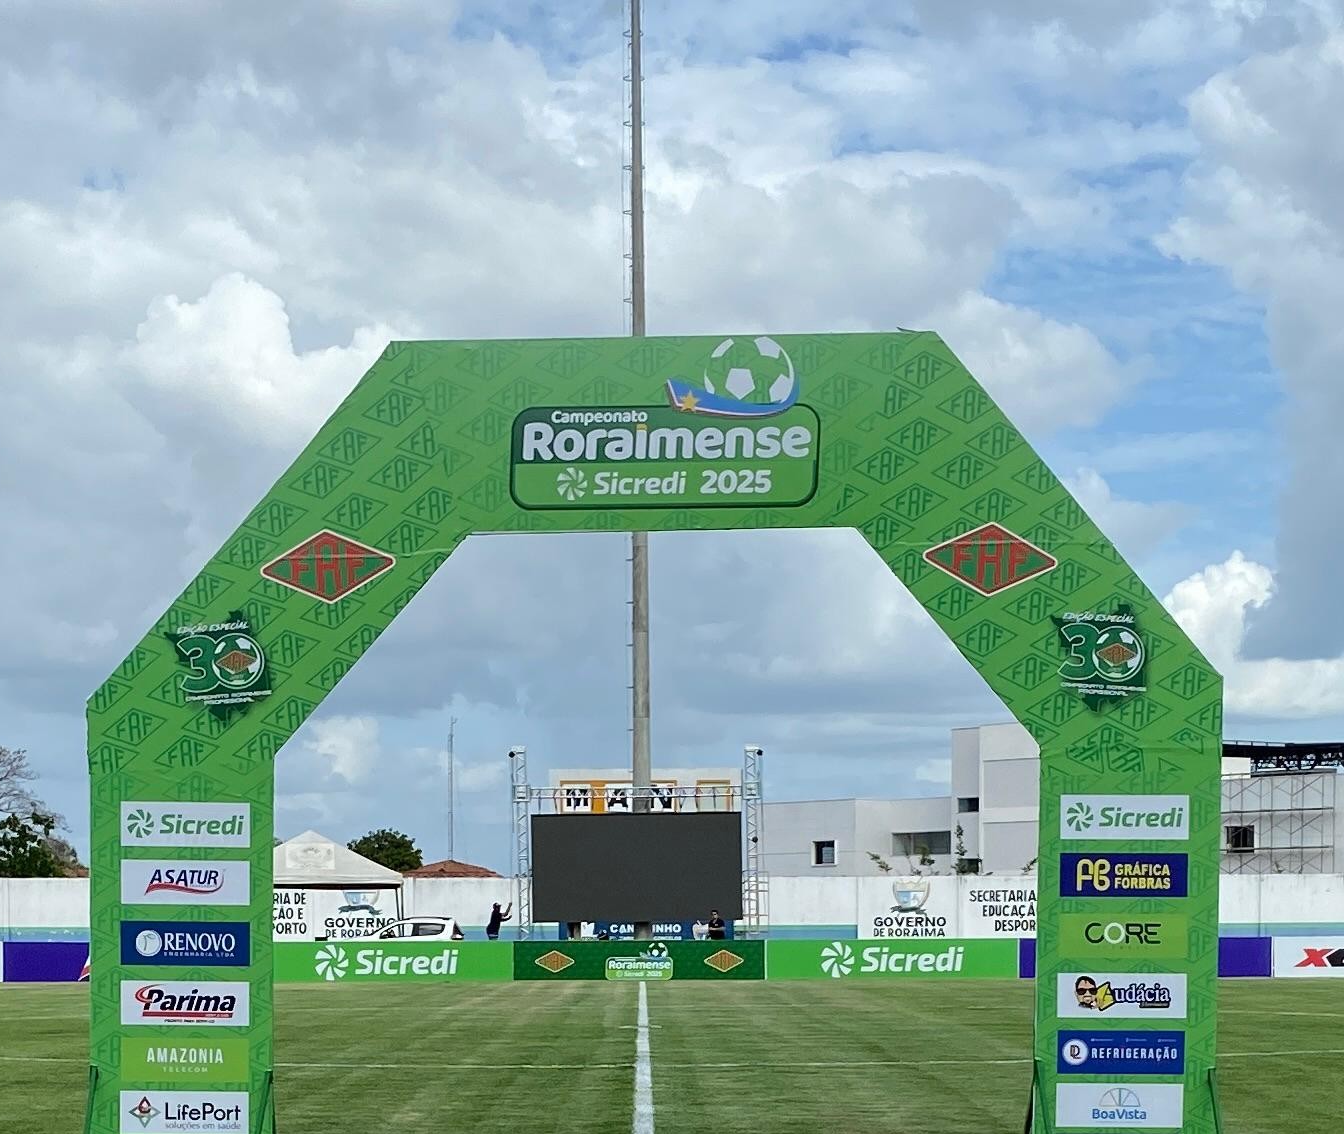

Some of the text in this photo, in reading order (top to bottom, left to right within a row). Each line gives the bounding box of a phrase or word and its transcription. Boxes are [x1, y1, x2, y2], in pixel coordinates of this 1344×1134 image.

[551, 410, 648, 426] Campeonato
[522, 421, 812, 461] Roraimense
[593, 469, 773, 495] Sicredi 2025
[159, 813, 245, 835] Sicredi
[1098, 806, 1184, 829] Sicredi
[1114, 861, 1171, 876] GRÁFICA
[149, 868, 219, 887] ASATUR
[1114, 877, 1171, 889] FORBRAS
[294, 892, 307, 905] DE
[969, 889, 1037, 902] SECRETARIA
[982, 901, 1036, 919] EDUCAÇÃ
[873, 916, 947, 928] GOVERNO
[994, 919, 1037, 932] DESPOR
[325, 928, 337, 938] DE
[873, 927, 946, 938] DE RORAIMA
[1084, 922, 1162, 945] CORE
[163, 932, 236, 952] RENOVO
[355, 949, 459, 976] Sicredi
[607, 959, 672, 970] Roraimense
[860, 946, 965, 973] Sicredi
[143, 987, 237, 1012] Parima
[1097, 982, 1171, 1009] Audácia
[146, 1047, 225, 1064] AMAZONIA
[1090, 1046, 1178, 1062] REFRIGERAÇÃO
[164, 1101, 242, 1122] LifePort
[1092, 1109, 1147, 1121] BoaVista
